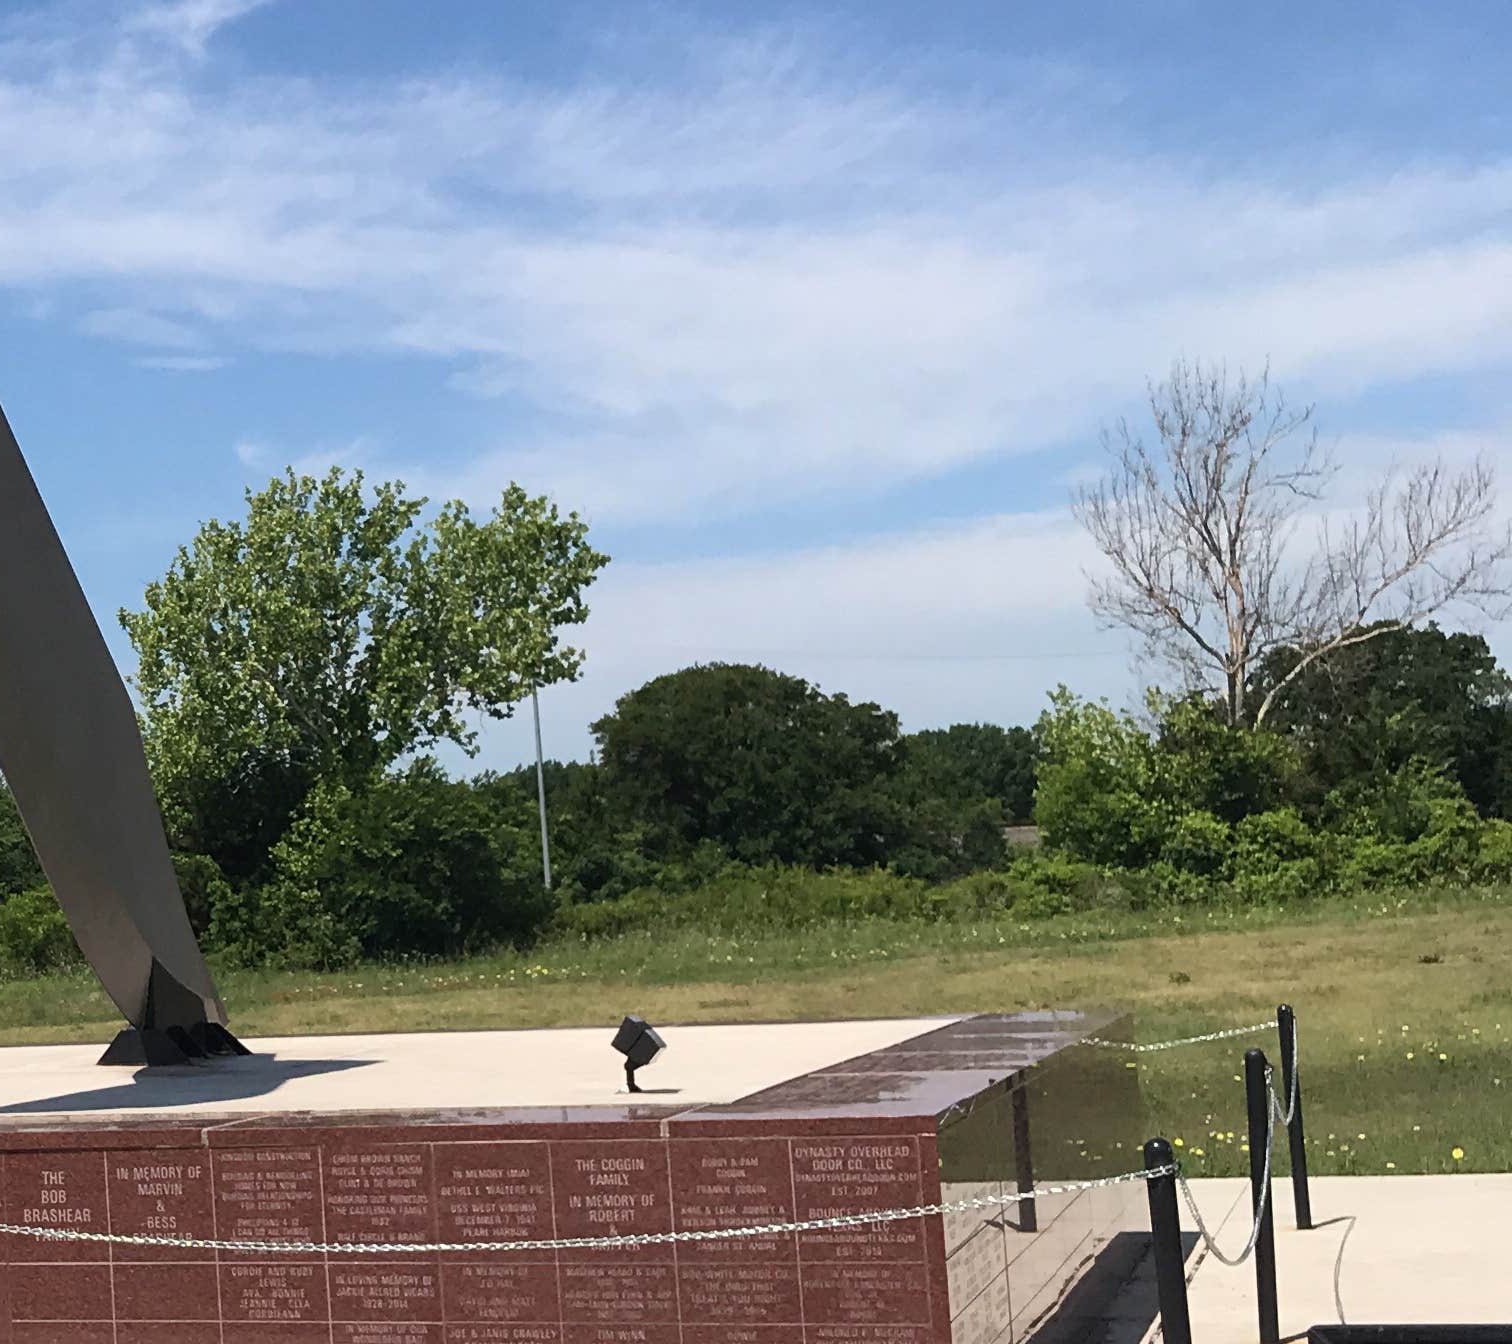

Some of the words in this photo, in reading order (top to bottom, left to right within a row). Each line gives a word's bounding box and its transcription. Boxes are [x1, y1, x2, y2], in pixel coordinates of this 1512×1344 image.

[795, 1147, 846, 1158] DYNASTY
[850, 1146, 910, 1157] OVERHEAD
[575, 1159, 597, 1171] THE
[601, 1158, 645, 1171] COGGIN
[41, 1171, 65, 1185] THE
[116, 1169, 128, 1180] IN
[133, 1167, 182, 1181] MEMORY
[188, 1166, 202, 1178] OF
[590, 1174, 630, 1186] FAMILY
[138, 1184, 184, 1196] MARVIN
[40, 1190, 66, 1204] BOB
[569, 1196, 582, 1207] IN
[586, 1194, 635, 1207] MEMORY
[641, 1193, 655, 1206] OF
[156, 1200, 166, 1212] &
[23, 1208, 91, 1223] BRASHEAR
[589, 1209, 635, 1223] ROBERT
[147, 1216, 176, 1229] BESS
